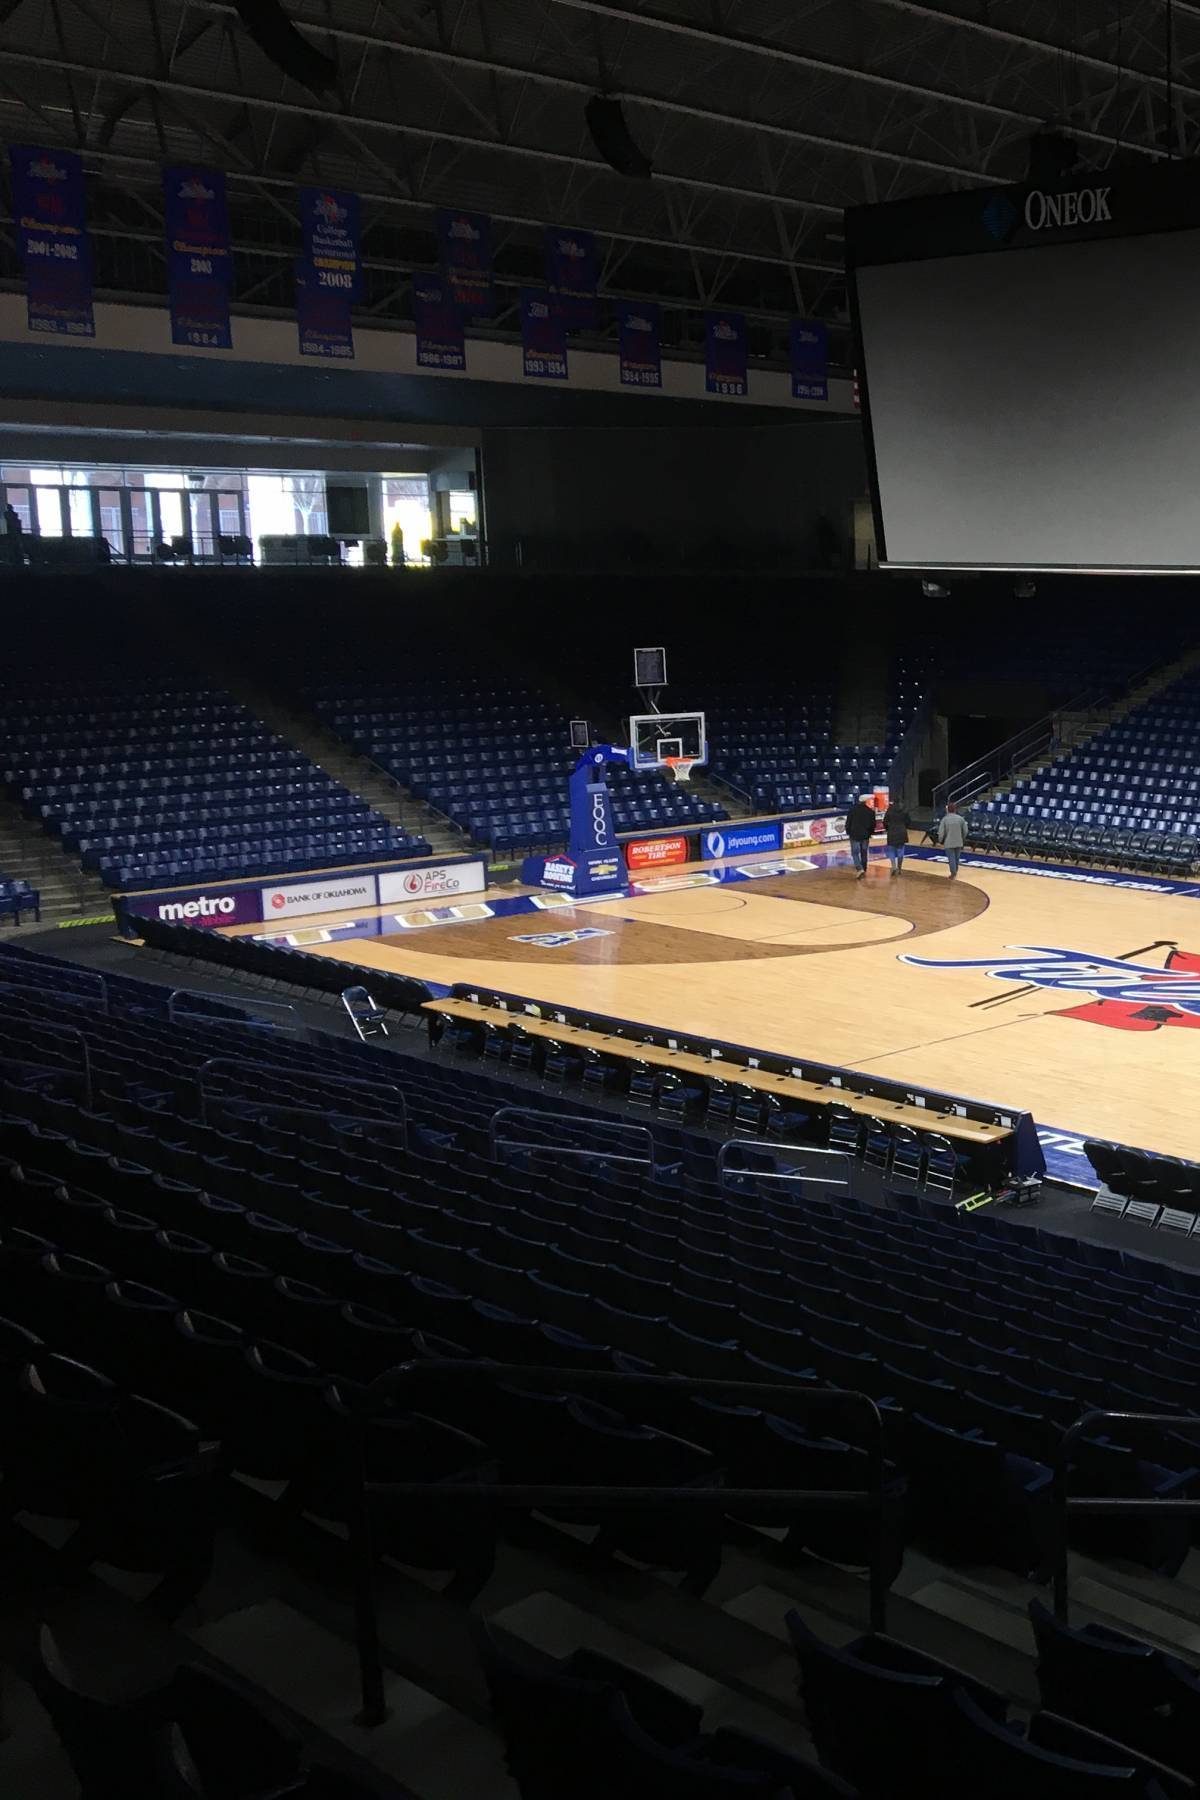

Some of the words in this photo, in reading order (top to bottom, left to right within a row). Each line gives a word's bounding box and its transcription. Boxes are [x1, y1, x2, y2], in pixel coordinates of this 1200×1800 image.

[1025, 186, 1112, 231] ONEOK
[728, 832, 775, 848] jdyoung.com
[425, 870, 446, 881] APS
[287, 893, 311, 904] BANK
[159, 896, 235, 920] metro
